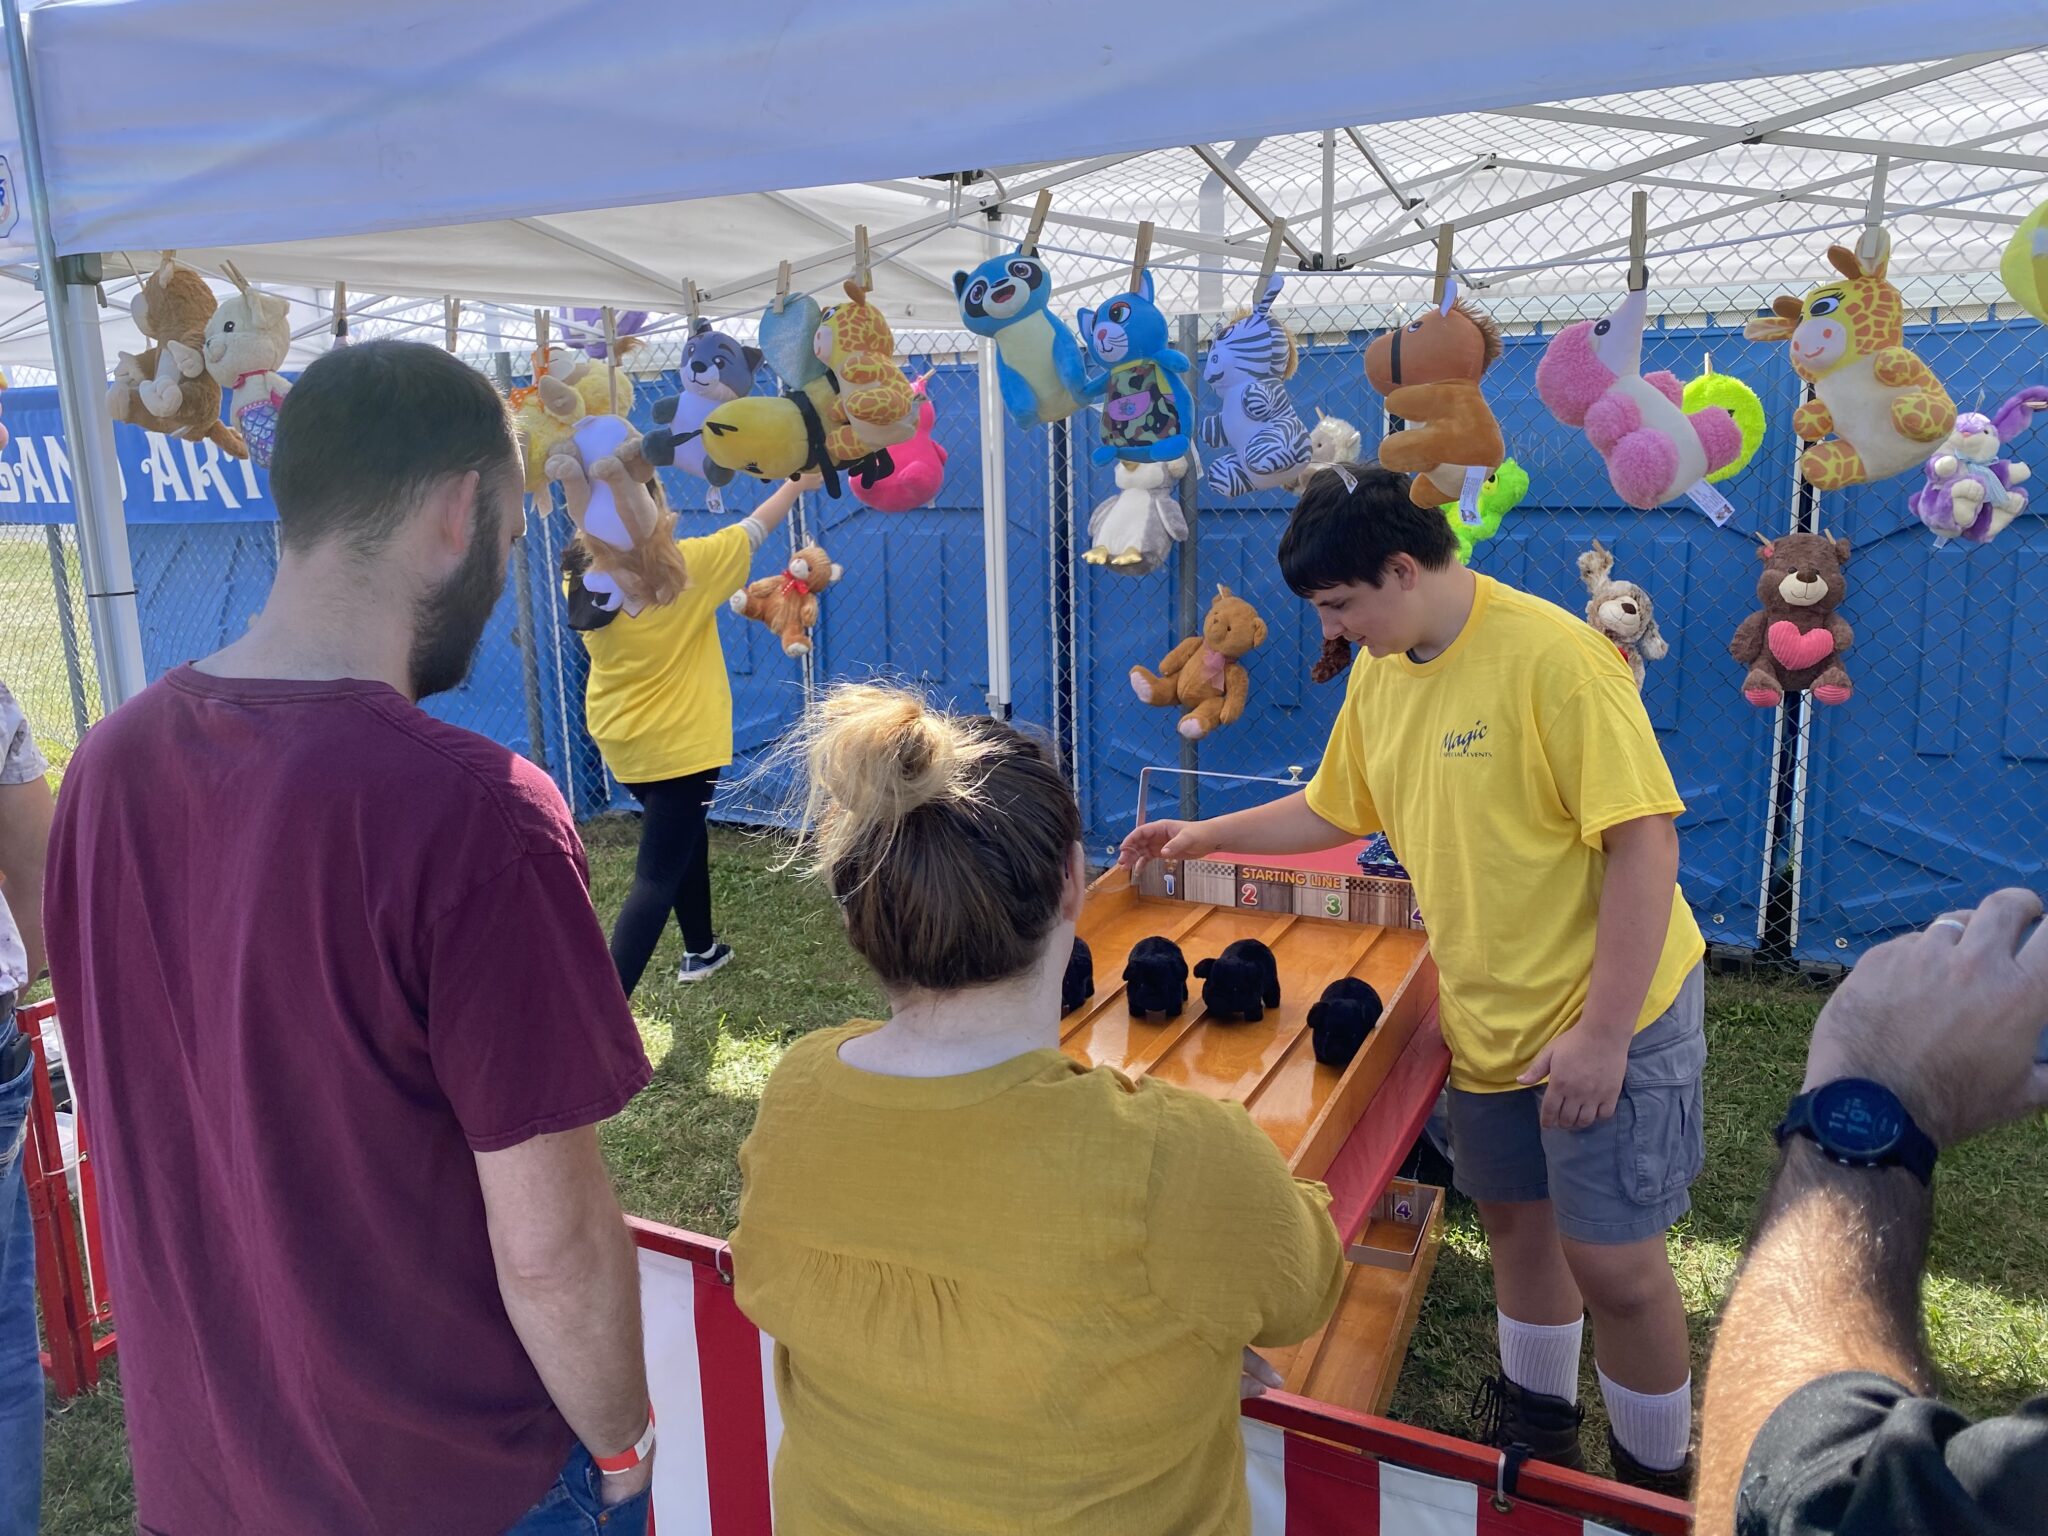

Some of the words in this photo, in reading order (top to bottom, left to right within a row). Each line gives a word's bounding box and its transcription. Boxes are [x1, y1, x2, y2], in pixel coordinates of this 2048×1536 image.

[1442, 720, 1487, 754] Magic
[1163, 874, 1175, 896] 1
[1242, 867, 1306, 885] STARTING
[1310, 875, 1341, 889] LINE
[1241, 883, 1258, 905] 2
[1325, 893, 1342, 916] 3
[1395, 1201, 1412, 1219] 4
